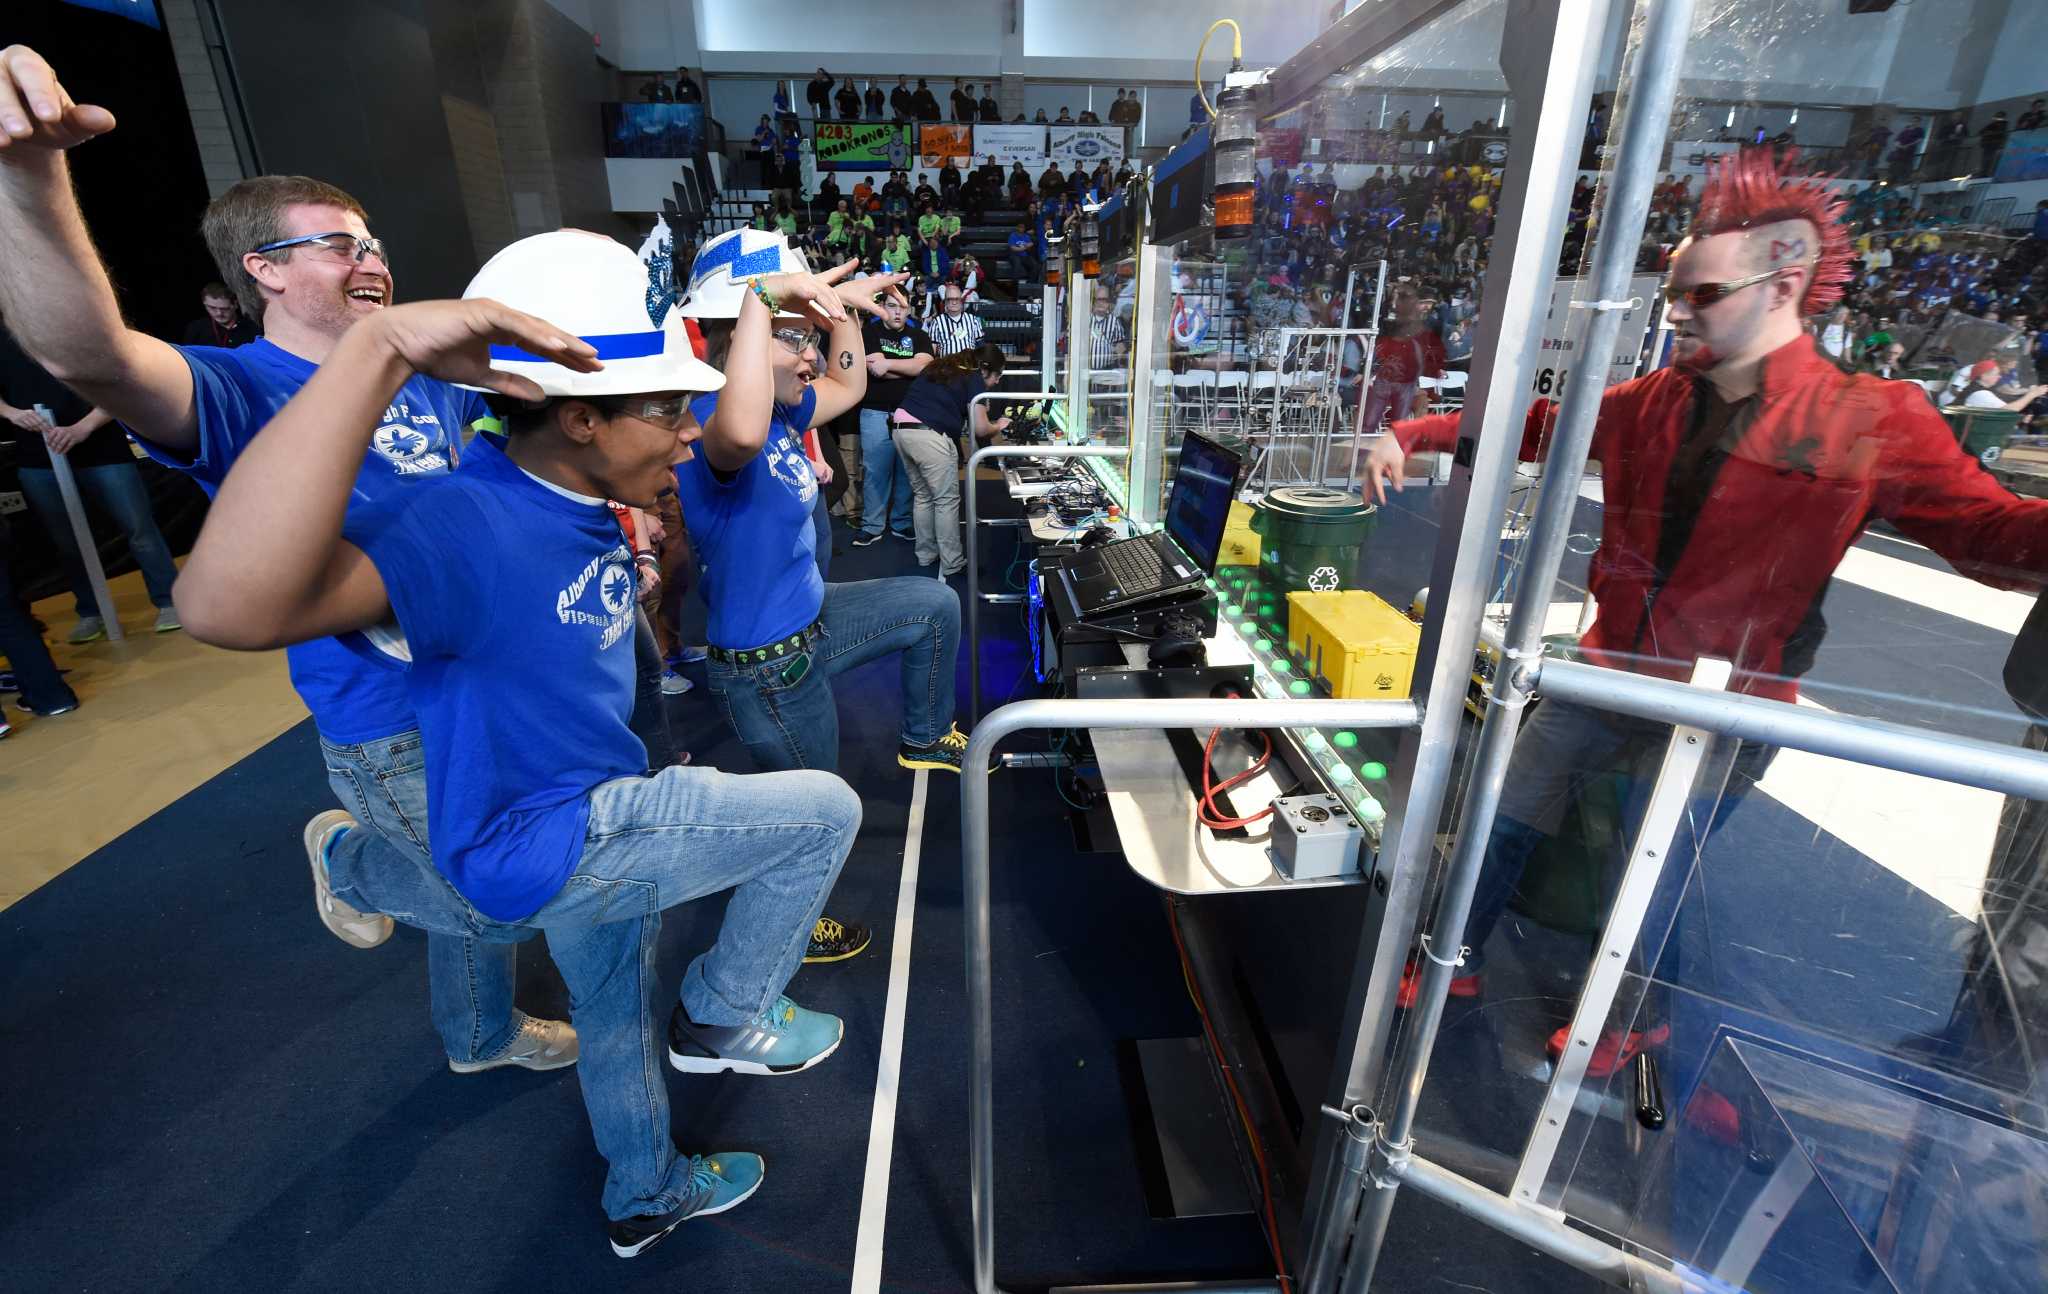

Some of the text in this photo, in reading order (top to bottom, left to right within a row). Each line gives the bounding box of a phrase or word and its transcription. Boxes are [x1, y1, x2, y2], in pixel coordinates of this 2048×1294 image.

[817, 125, 852, 139] 4203
[818, 125, 892, 160] ROBOKRONOS
[557, 556, 599, 616] Albany
